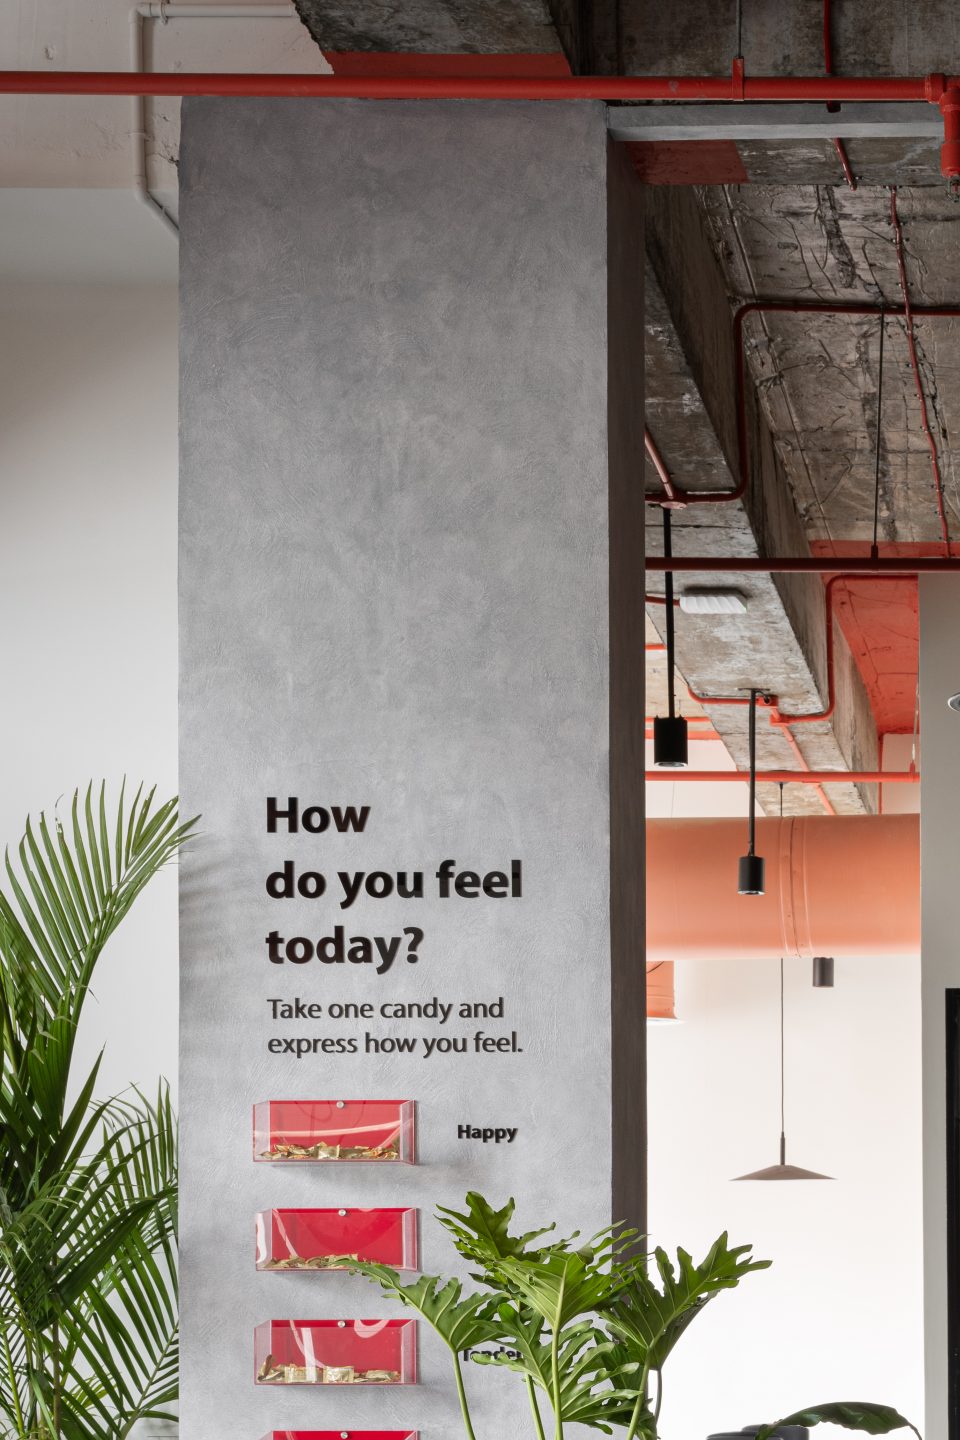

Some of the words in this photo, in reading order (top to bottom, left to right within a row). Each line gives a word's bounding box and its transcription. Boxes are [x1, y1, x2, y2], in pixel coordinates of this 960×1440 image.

[267, 796, 371, 834] How
[266, 860, 326, 899] do
[338, 871, 424, 910] you
[436, 859, 522, 898] feel
[266, 925, 424, 974] today?
[267, 998, 322, 1020] Take
[328, 1003, 374, 1019] one
[380, 997, 454, 1025] candy
[459, 997, 504, 1019] and
[267, 1036, 358, 1059] express
[366, 1031, 417, 1054] how
[423, 1038, 468, 1059] you
[473, 1031, 523, 1053] feel.
[457, 1124, 518, 1144] Happy
